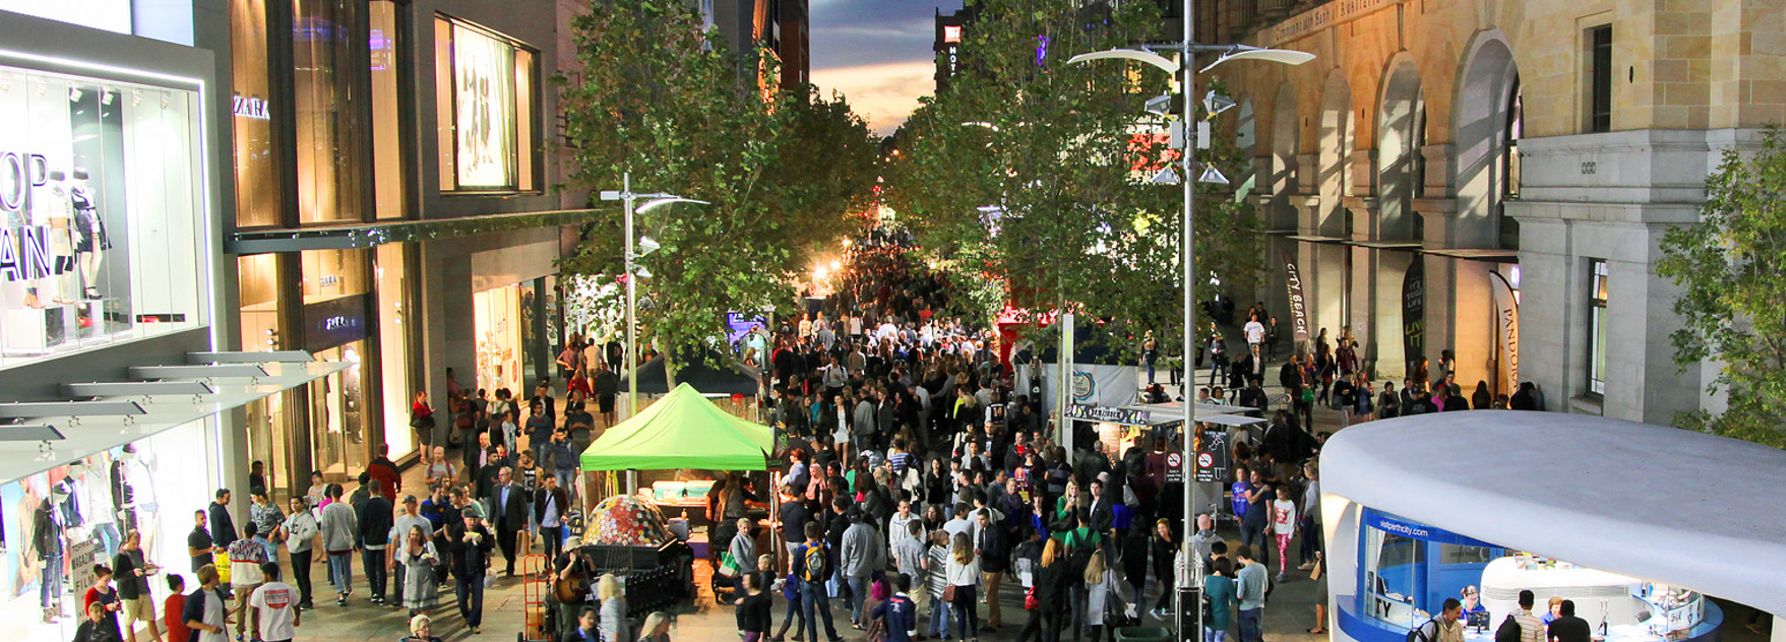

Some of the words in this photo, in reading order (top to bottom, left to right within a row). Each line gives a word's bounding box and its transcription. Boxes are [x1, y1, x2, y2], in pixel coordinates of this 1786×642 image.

[232, 94, 270, 120] ZARA
[1287, 263, 1301, 290] CITY
[1292, 294, 1307, 334] BEACH
[1503, 308, 1518, 388] PANDORA
[1379, 519, 1429, 537] visitperthcity.com
